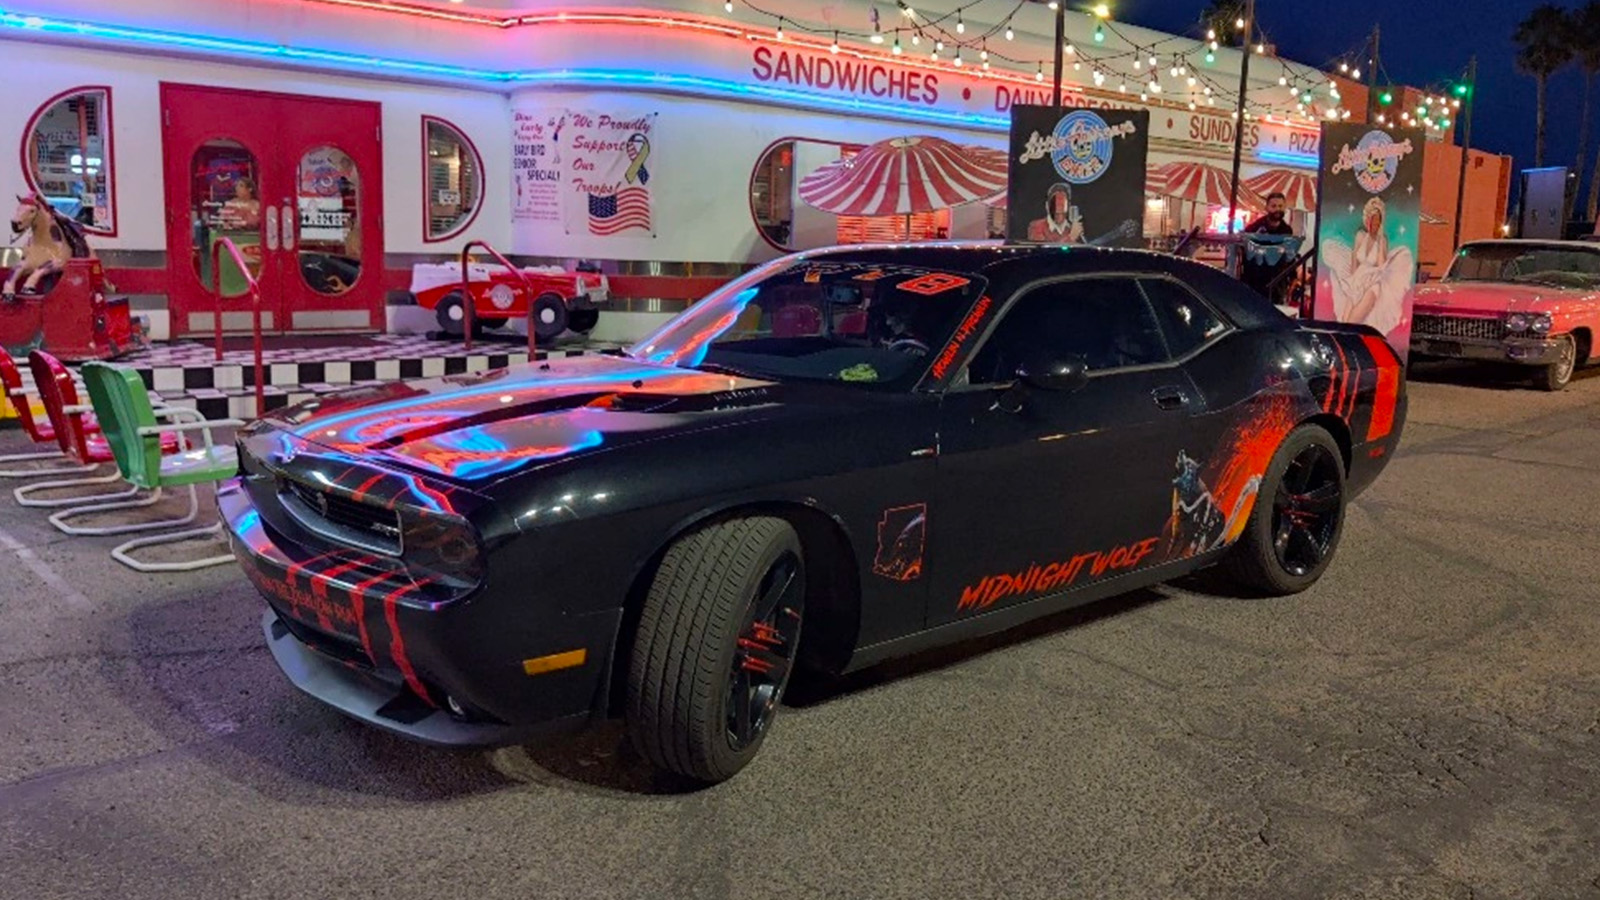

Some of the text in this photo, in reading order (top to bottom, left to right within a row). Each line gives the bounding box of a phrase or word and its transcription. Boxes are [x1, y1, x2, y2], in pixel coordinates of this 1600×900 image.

[752, 46, 939, 105] SANDWICHES
[573, 113, 651, 134] We Proudly
[572, 135, 626, 153] Support
[1288, 131, 1318, 154] PIZZ
[513, 158, 536, 169] SENIOR
[572, 157, 595, 171] Our
[572, 177, 621, 195] Troops!
[956, 537, 1160, 612] MIDNIGHT WOLF
